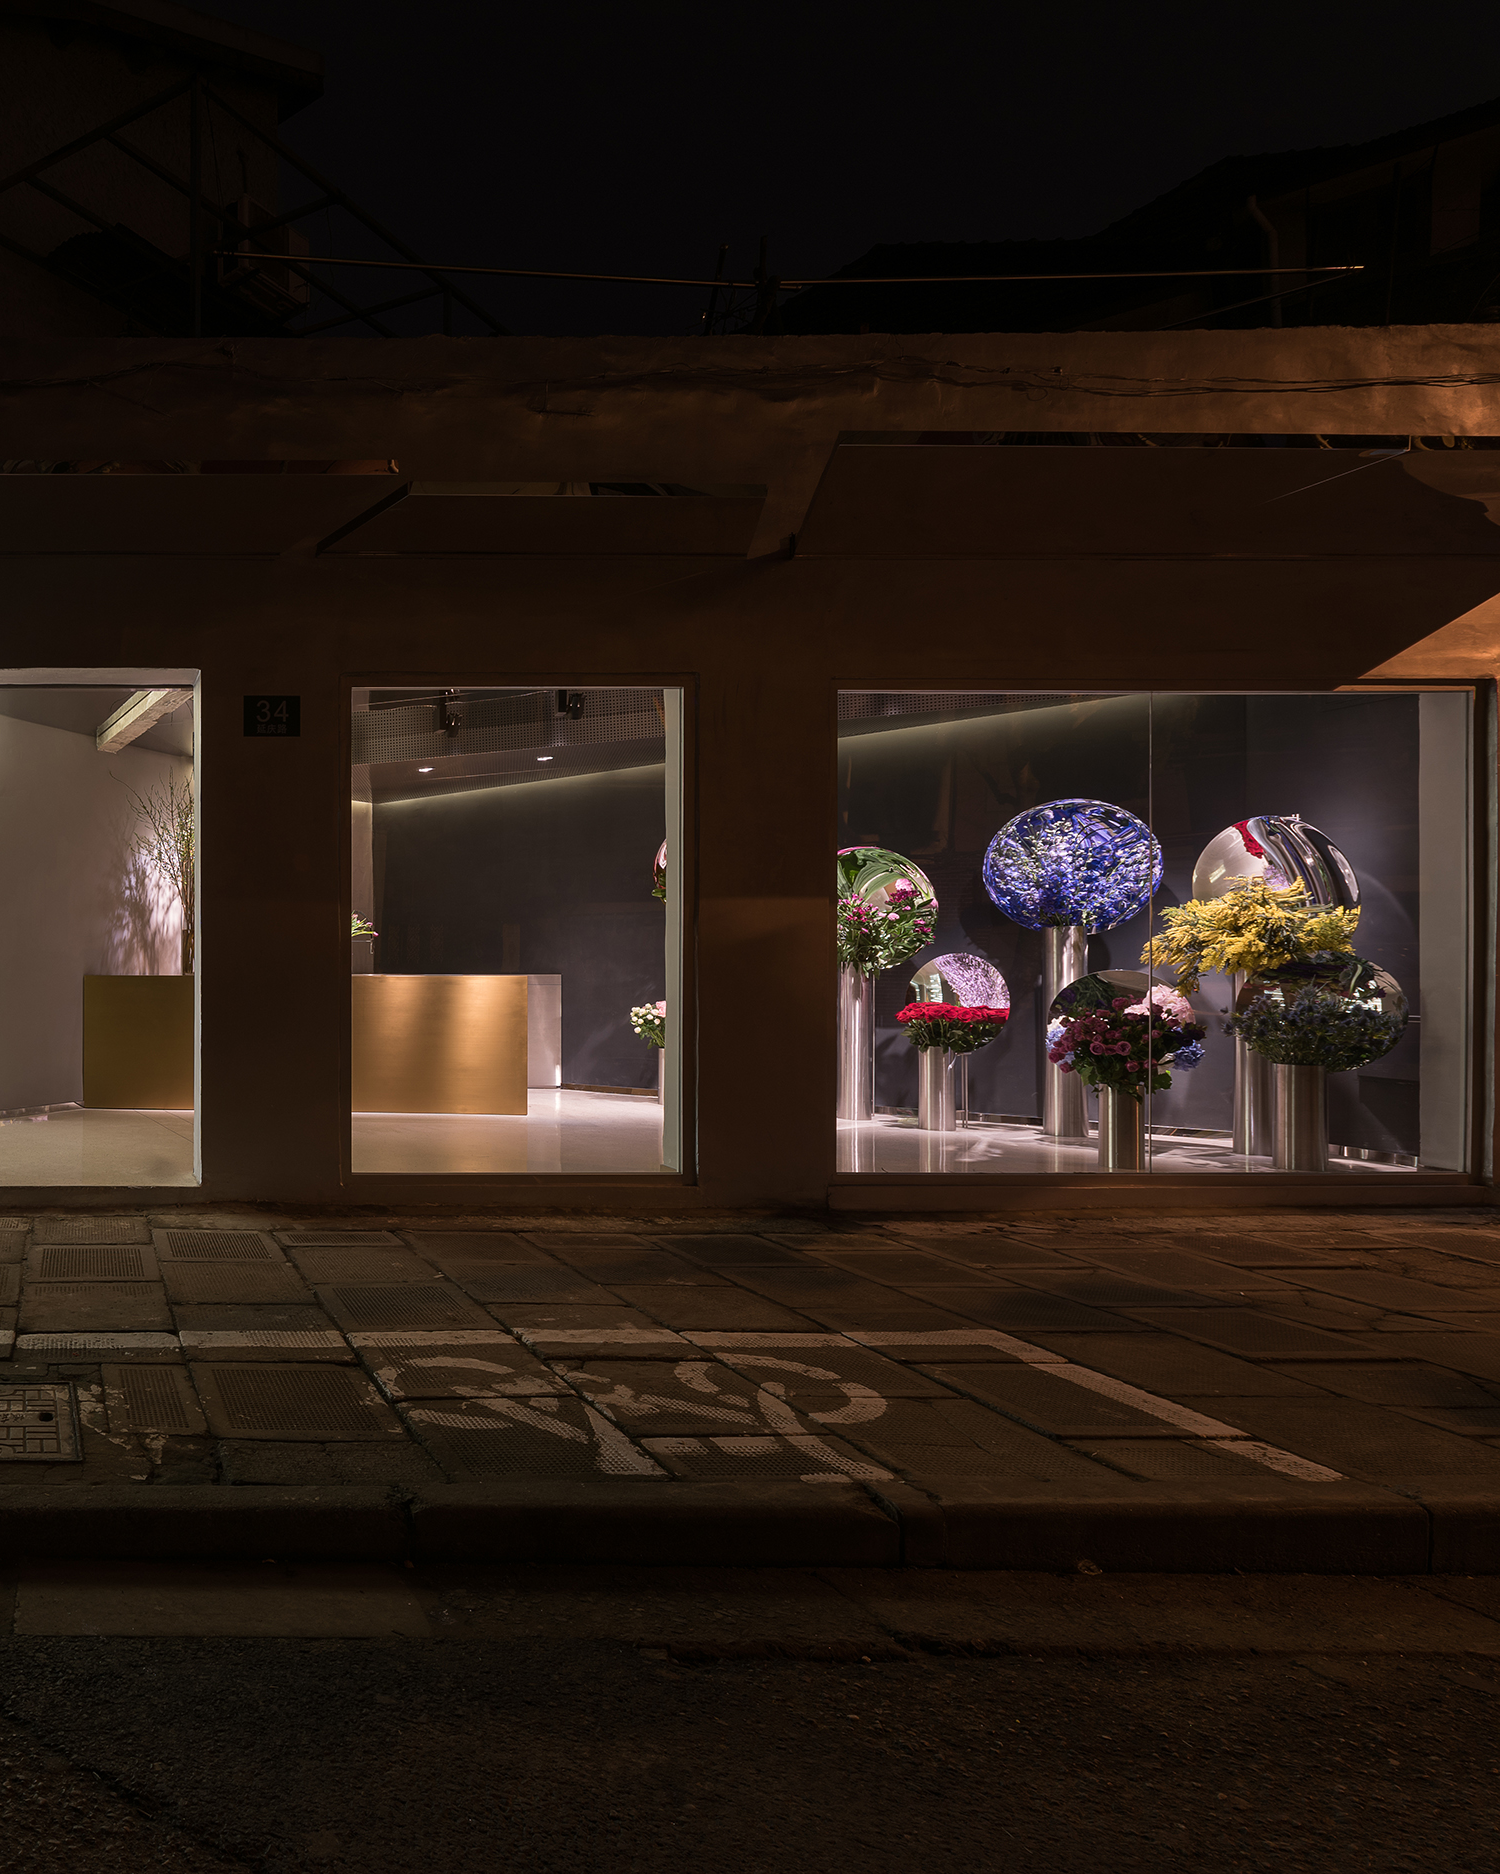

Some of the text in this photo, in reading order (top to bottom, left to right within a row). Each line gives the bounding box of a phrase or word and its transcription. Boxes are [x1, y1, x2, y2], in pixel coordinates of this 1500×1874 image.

[256, 700, 290, 723] 34
[256, 723, 288, 734] 延庆路
